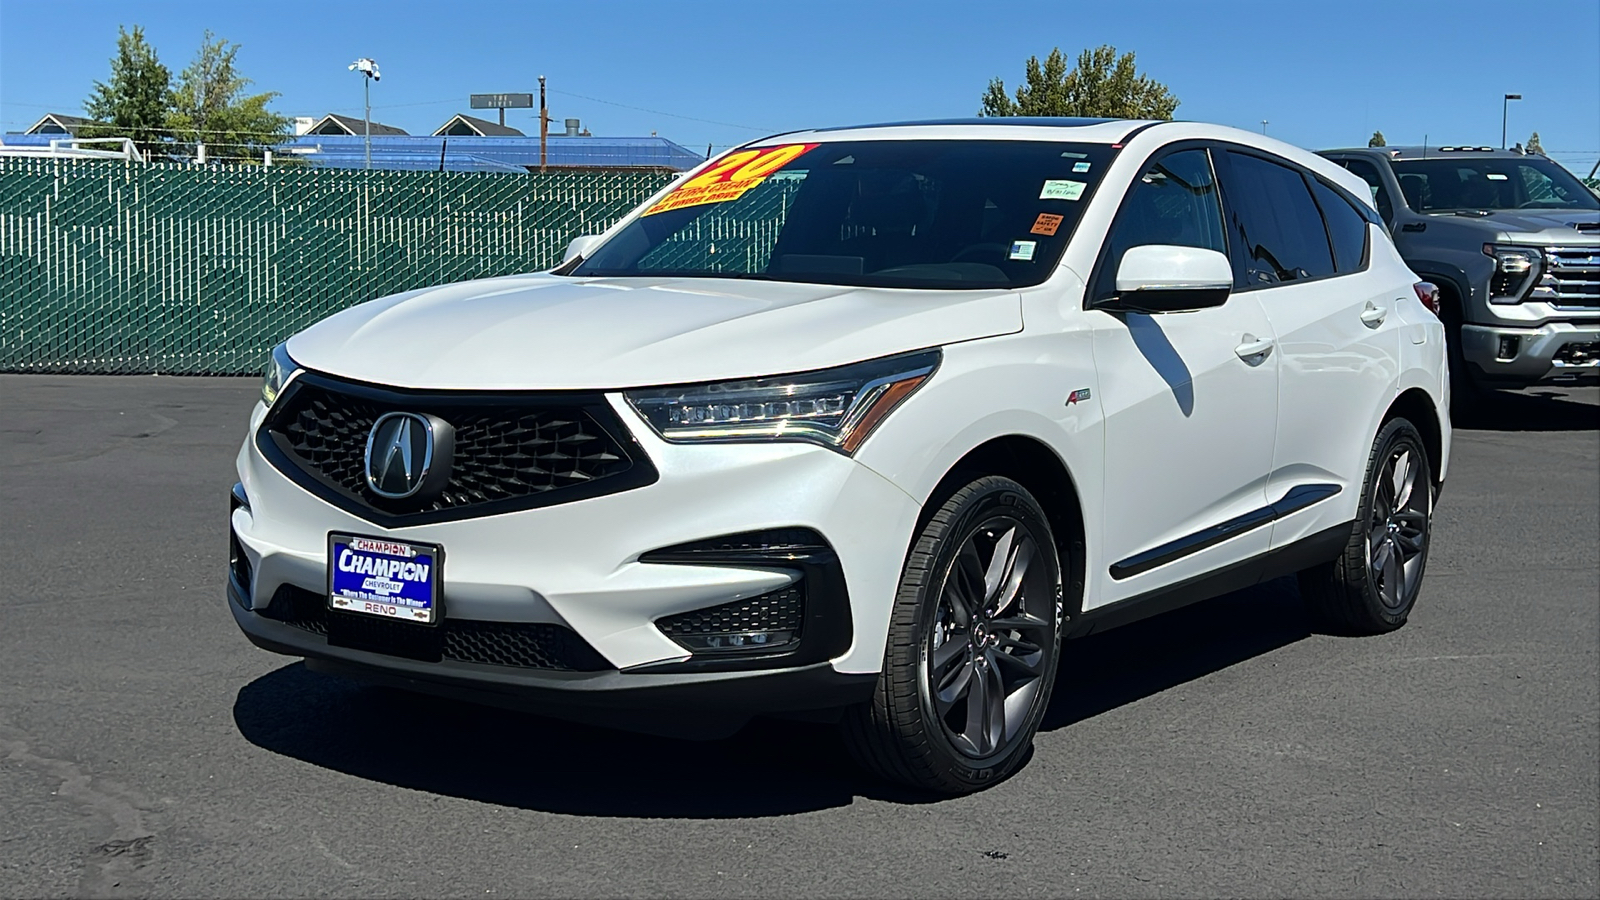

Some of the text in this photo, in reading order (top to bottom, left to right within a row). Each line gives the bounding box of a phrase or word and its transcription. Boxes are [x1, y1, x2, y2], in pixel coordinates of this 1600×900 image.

[680, 144, 806, 190] 20
[664, 186, 710, 202] EXTRA
[358, 540, 407, 555] CHAMPION
[338, 549, 429, 583] CHAMPION
[364, 579, 401, 591] CHEVROLET
[364, 602, 397, 616] RENO
